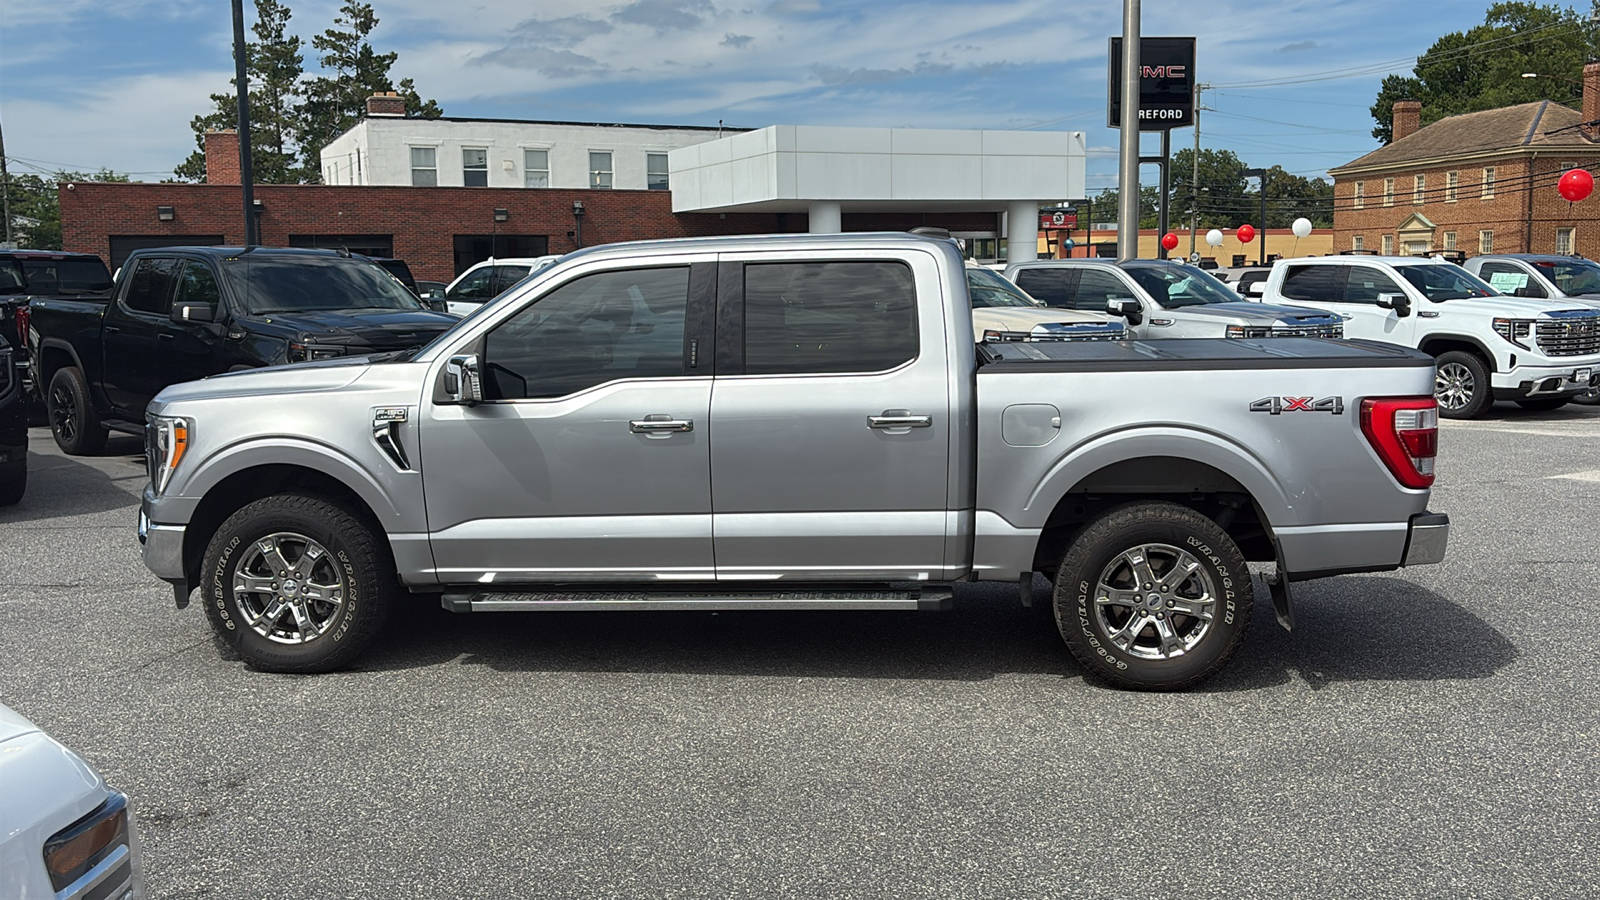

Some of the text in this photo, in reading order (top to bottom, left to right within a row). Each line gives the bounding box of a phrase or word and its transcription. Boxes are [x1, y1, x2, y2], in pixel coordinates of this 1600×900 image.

[1138, 109, 1183, 120] REFORD
[1139, 65, 1186, 78] MC
[213, 536, 241, 631] GOODYEAR
[332, 550, 357, 641] WRANGLER
[1187, 535, 1236, 625] WRANGLER
[1078, 580, 1128, 671] GOODYEAR
